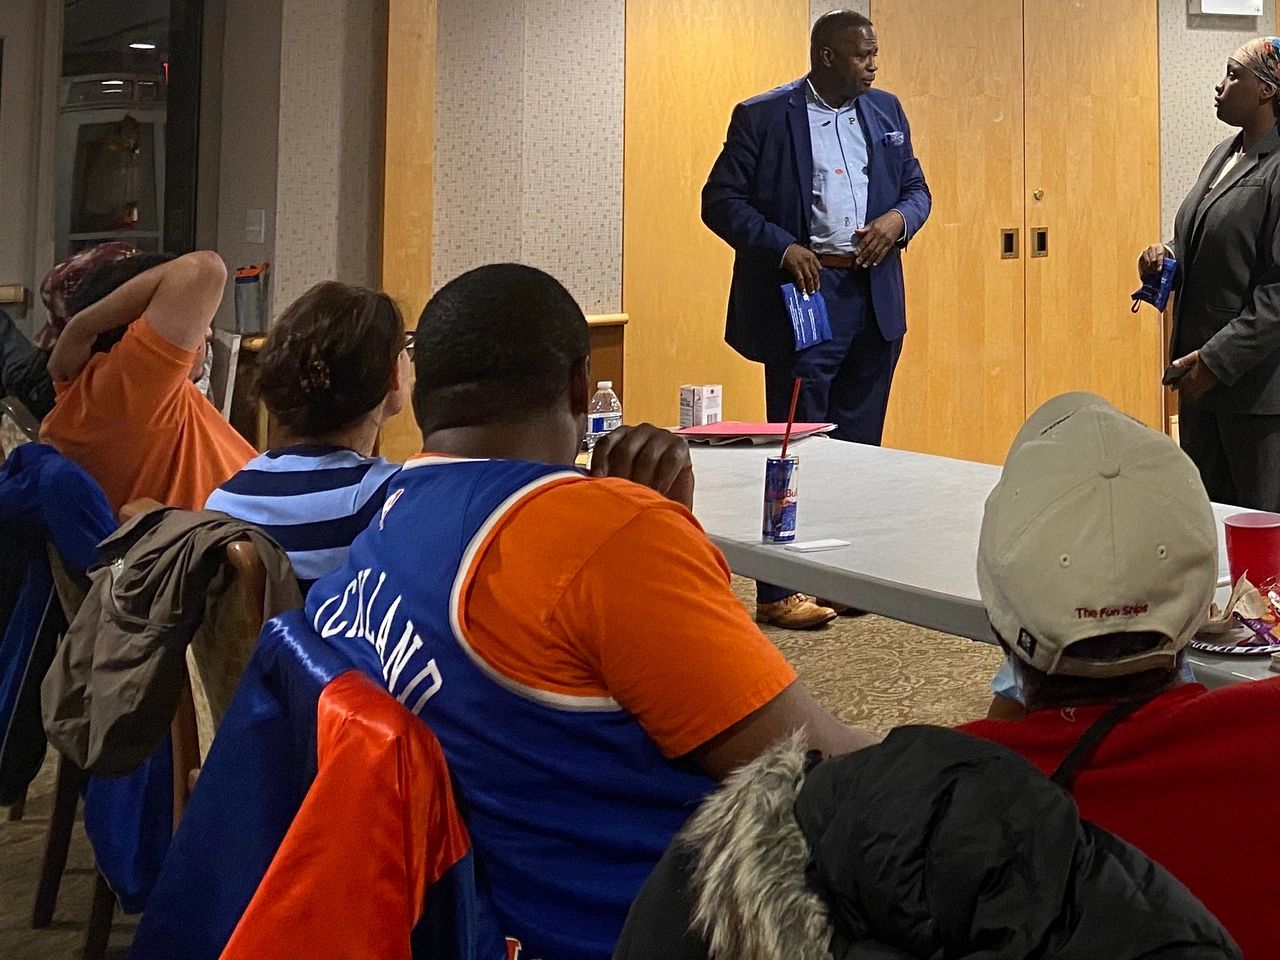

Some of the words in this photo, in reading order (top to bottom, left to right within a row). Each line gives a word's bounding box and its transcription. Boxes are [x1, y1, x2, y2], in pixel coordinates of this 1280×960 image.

[1075, 607, 1098, 619] The
[1099, 607, 1120, 618] Fun
[1122, 604, 1149, 617] Ships
